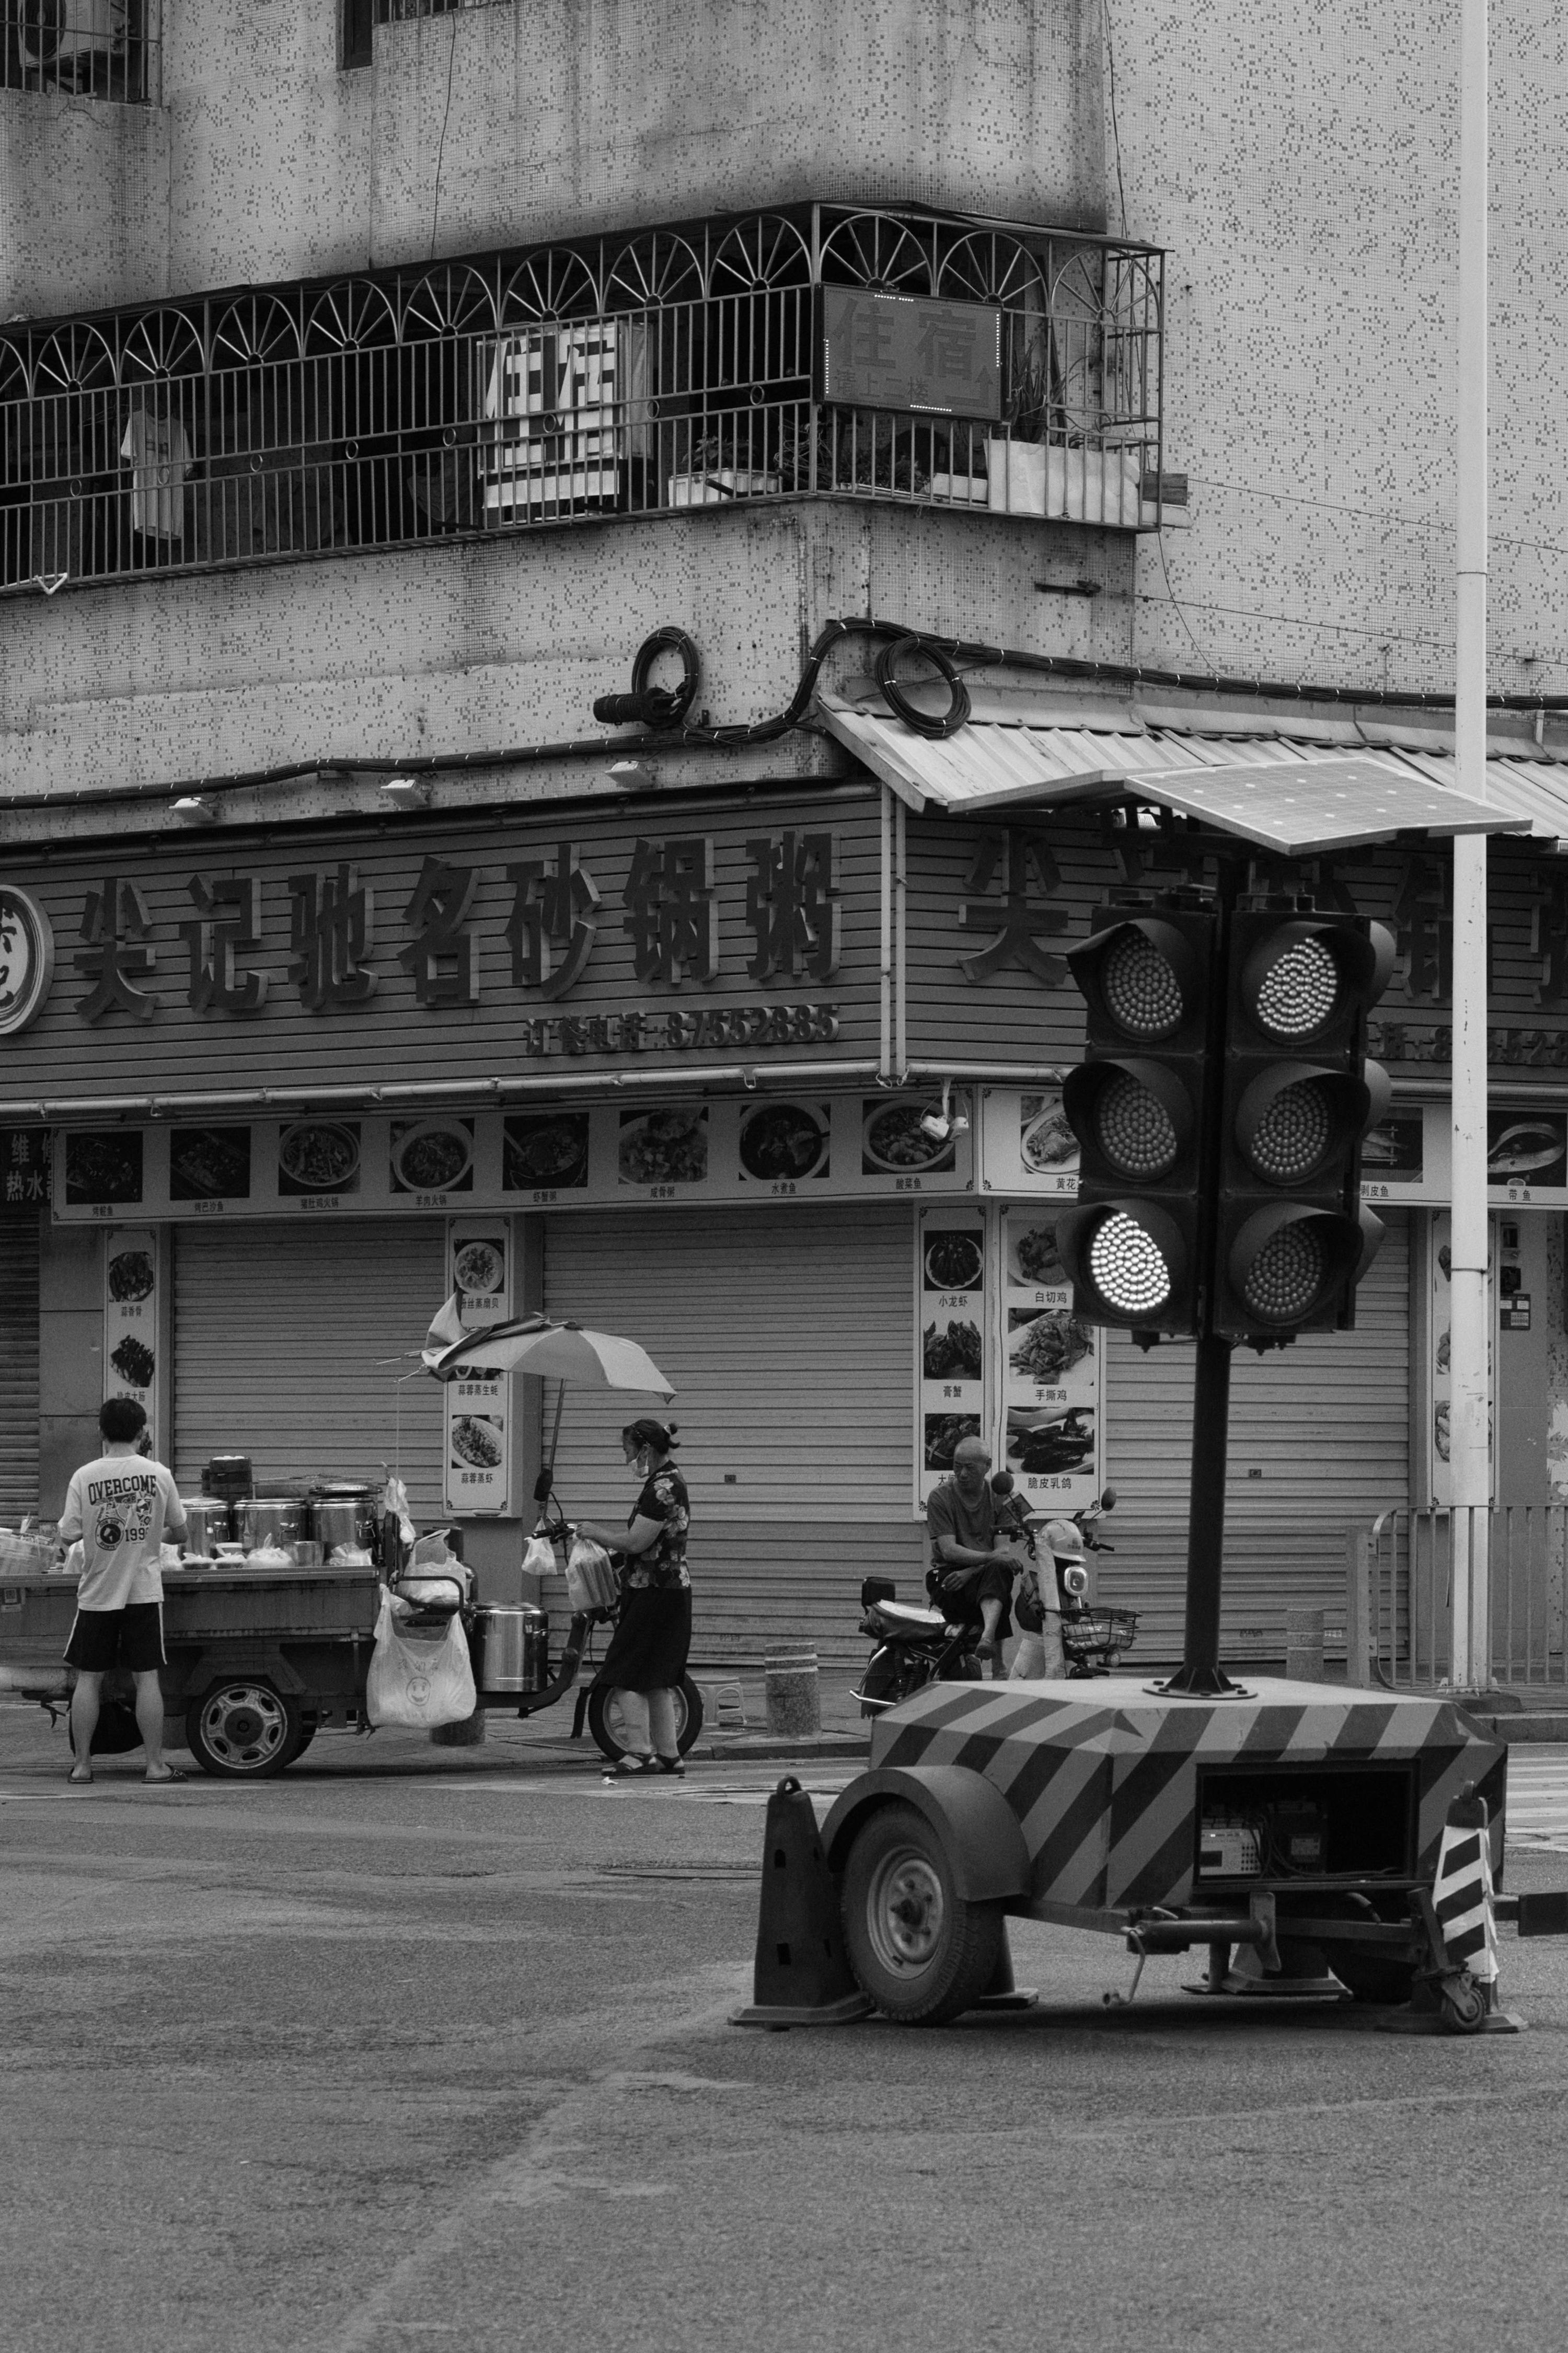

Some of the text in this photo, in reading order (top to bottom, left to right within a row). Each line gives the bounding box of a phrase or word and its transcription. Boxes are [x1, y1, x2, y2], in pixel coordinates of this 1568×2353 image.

[833, 296, 977, 380] 住宿
[486, 325, 615, 470] 住宿
[74, 831, 842, 1023] 尖记驰名砂锅粥
[771, 1182, 796, 1194] 水煮鱼
[895, 1177, 921, 1190] 酸菜鱼
[1056, 1178, 1078, 1190] 黄花
[533, 1191, 557, 1202] 虾蟹粥
[650, 1186, 675, 1198] 咸骨粥
[301, 1197, 338, 1209] 猪肚鸡火锅
[416, 1194, 446, 1206] 羊肉火锅
[194, 1201, 224, 1213] 烤巴沙鱼
[939, 1295, 967, 1307] 小龙虾
[1035, 1291, 1067, 1304] 白切鸡
[458, 1384, 498, 1396] 蒜蓉蒸生蚝
[1035, 1389, 1067, 1402] 手撕鸡
[460, 1473, 492, 1484] 蒜蓉蒸虾
[1028, 1477, 1071, 1490] 脆皮乳鸽
[88, 1475, 156, 1506] OVERCOME
[125, 1527, 149, 1542] 199
